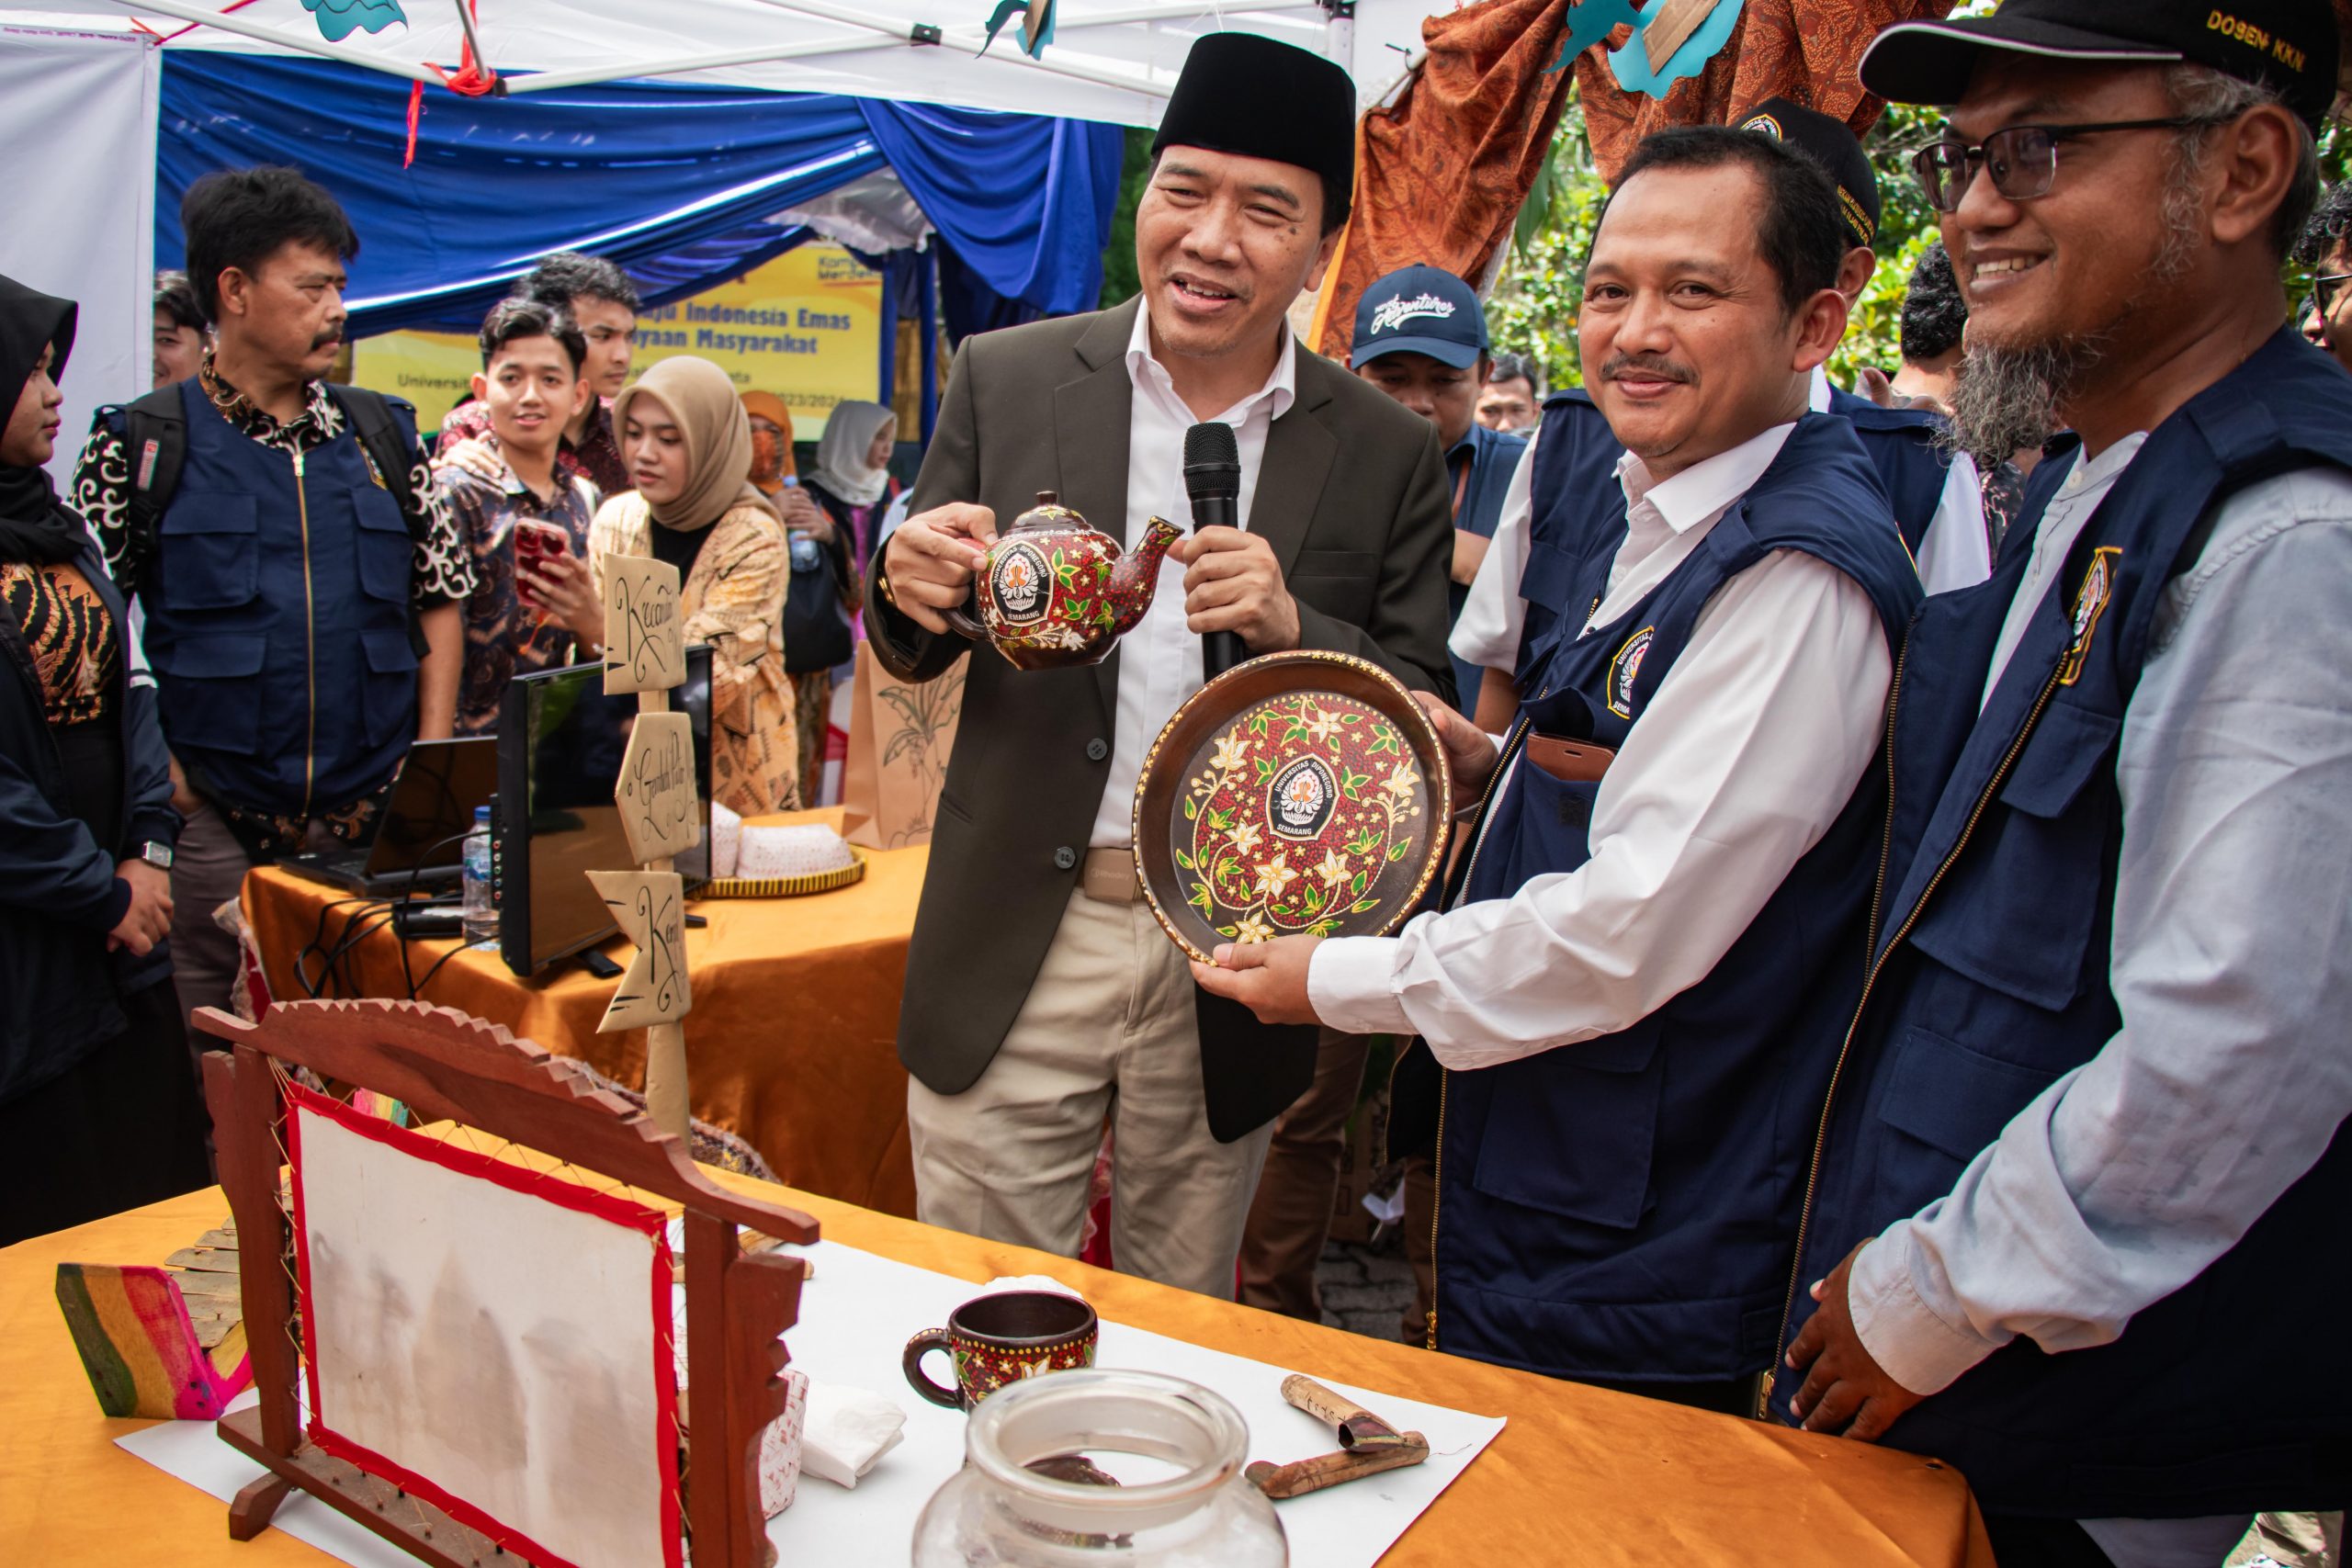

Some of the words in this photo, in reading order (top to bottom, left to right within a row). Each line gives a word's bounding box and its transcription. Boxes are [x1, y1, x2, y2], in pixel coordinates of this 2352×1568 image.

[2205, 9, 2271, 51] DOSEN
[2271, 38, 2306, 73] KKN
[686, 301, 788, 327] Indonesia
[797, 308, 852, 332] Emas
[695, 329, 820, 355] Masyarakat
[397, 372, 472, 389] Universit
[1019, 544, 1048, 578] DIPONEGORO
[1007, 610, 1040, 621] SEMARANG
[1273, 760, 1310, 792] UNIVERSITAS
[1310, 761, 1333, 798] DIPONEGORO
[1276, 823, 1312, 836] SEMARANG
